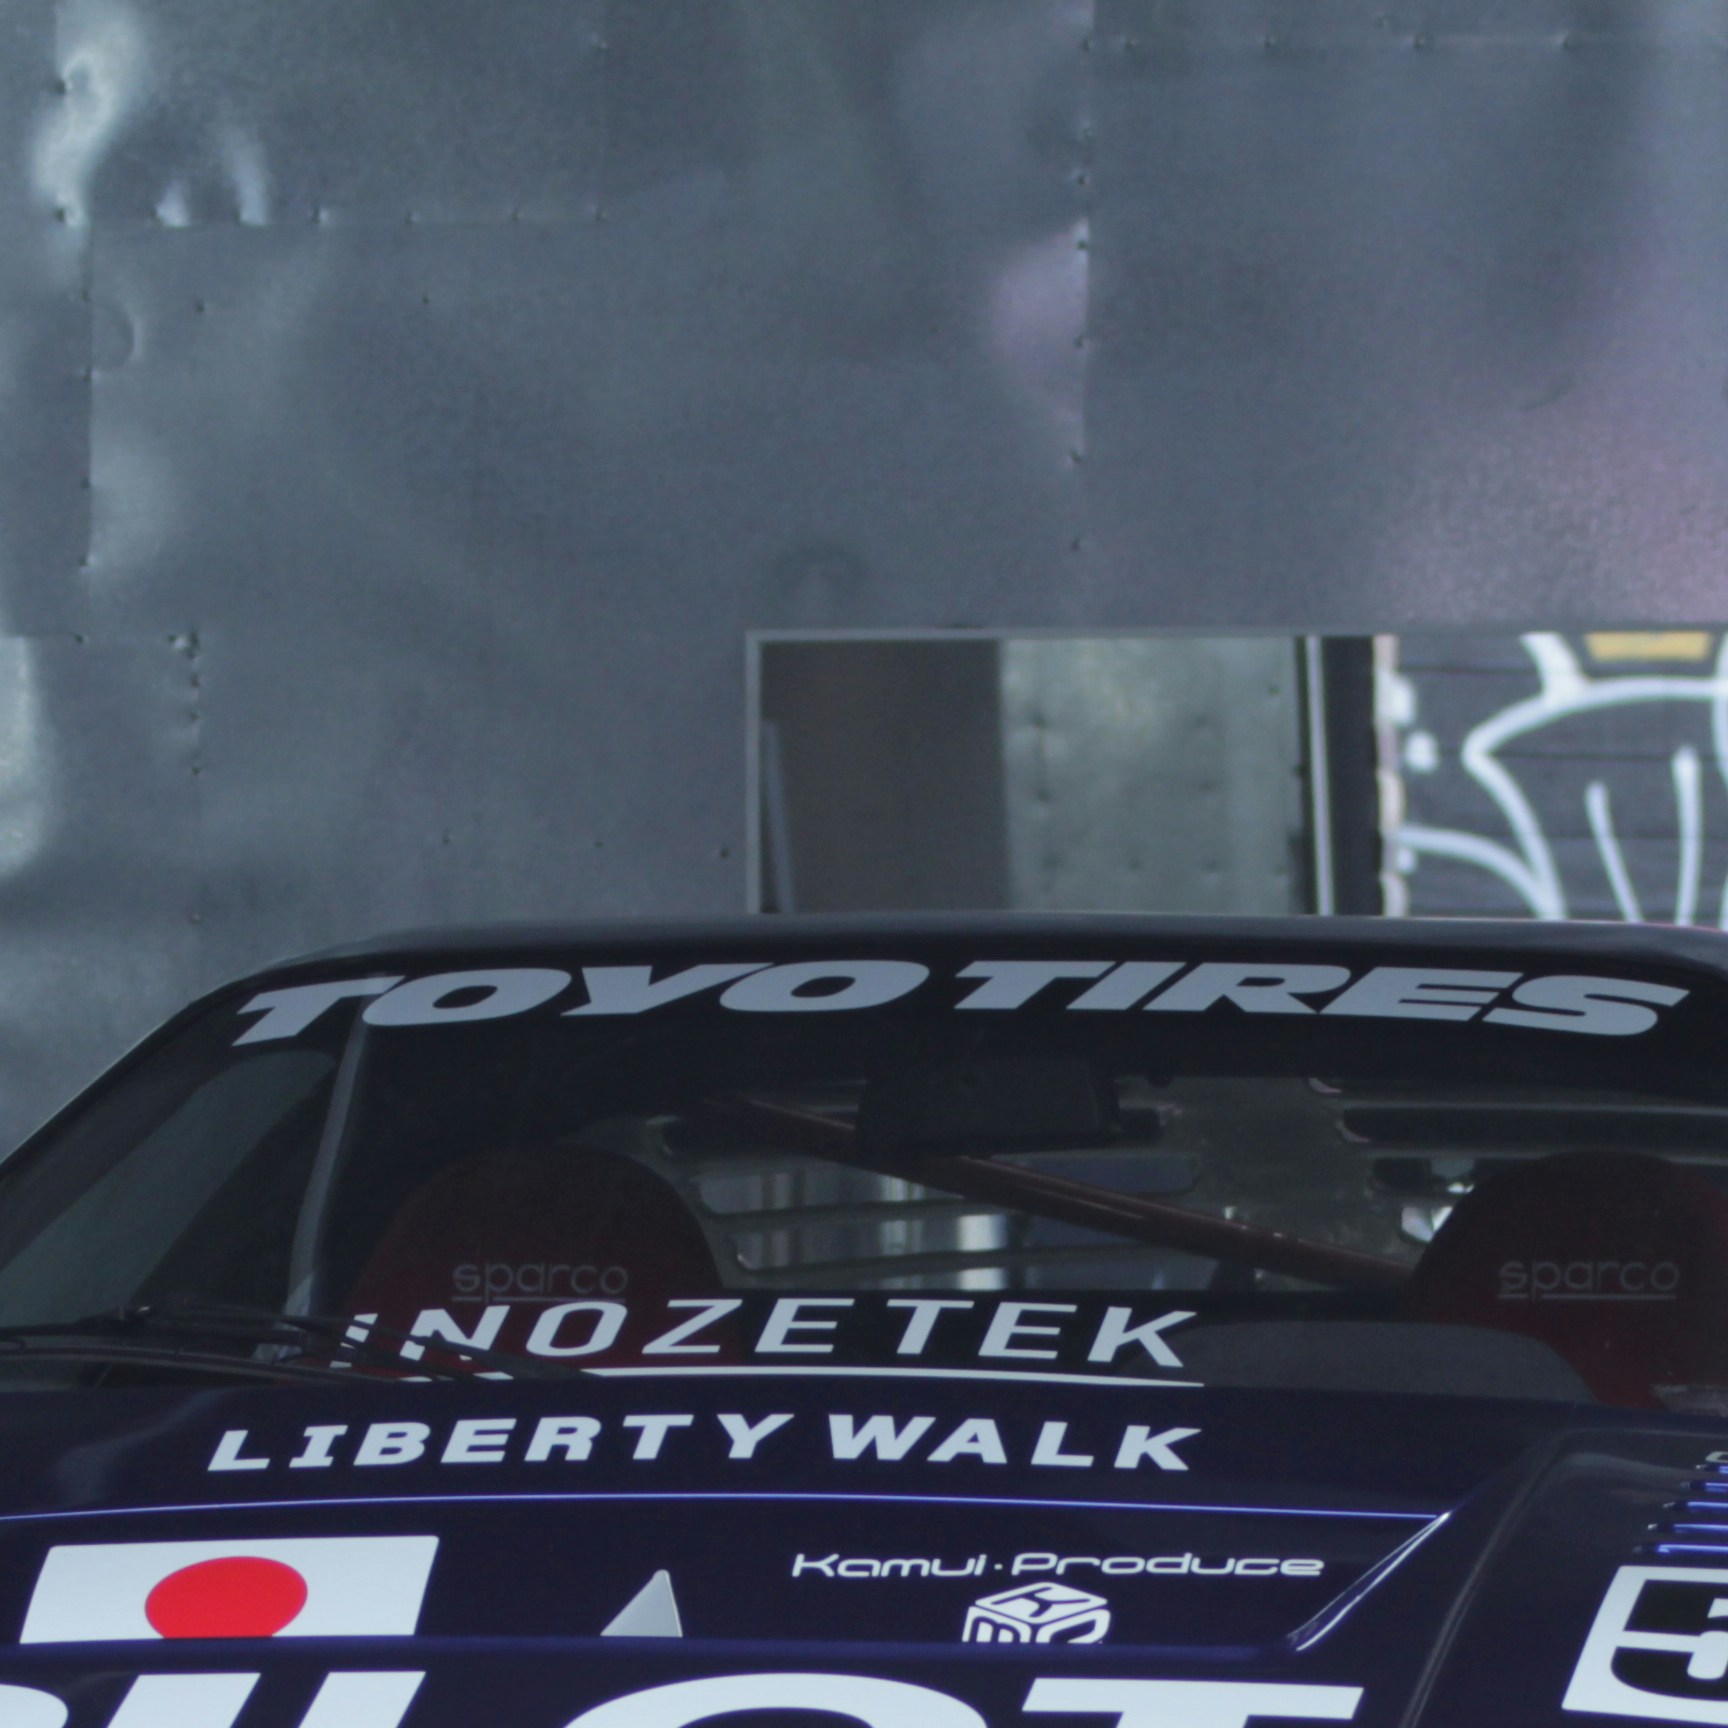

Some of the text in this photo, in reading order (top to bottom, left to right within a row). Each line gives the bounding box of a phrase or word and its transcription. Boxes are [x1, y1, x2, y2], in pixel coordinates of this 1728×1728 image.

[231, 961, 1689, 1046] TOYO TIRES
[452, 1262, 628, 1302] sparco
[1498, 1260, 1680, 1300] sparco
[206, 1413, 1202, 1473] LIBERTY WALK
